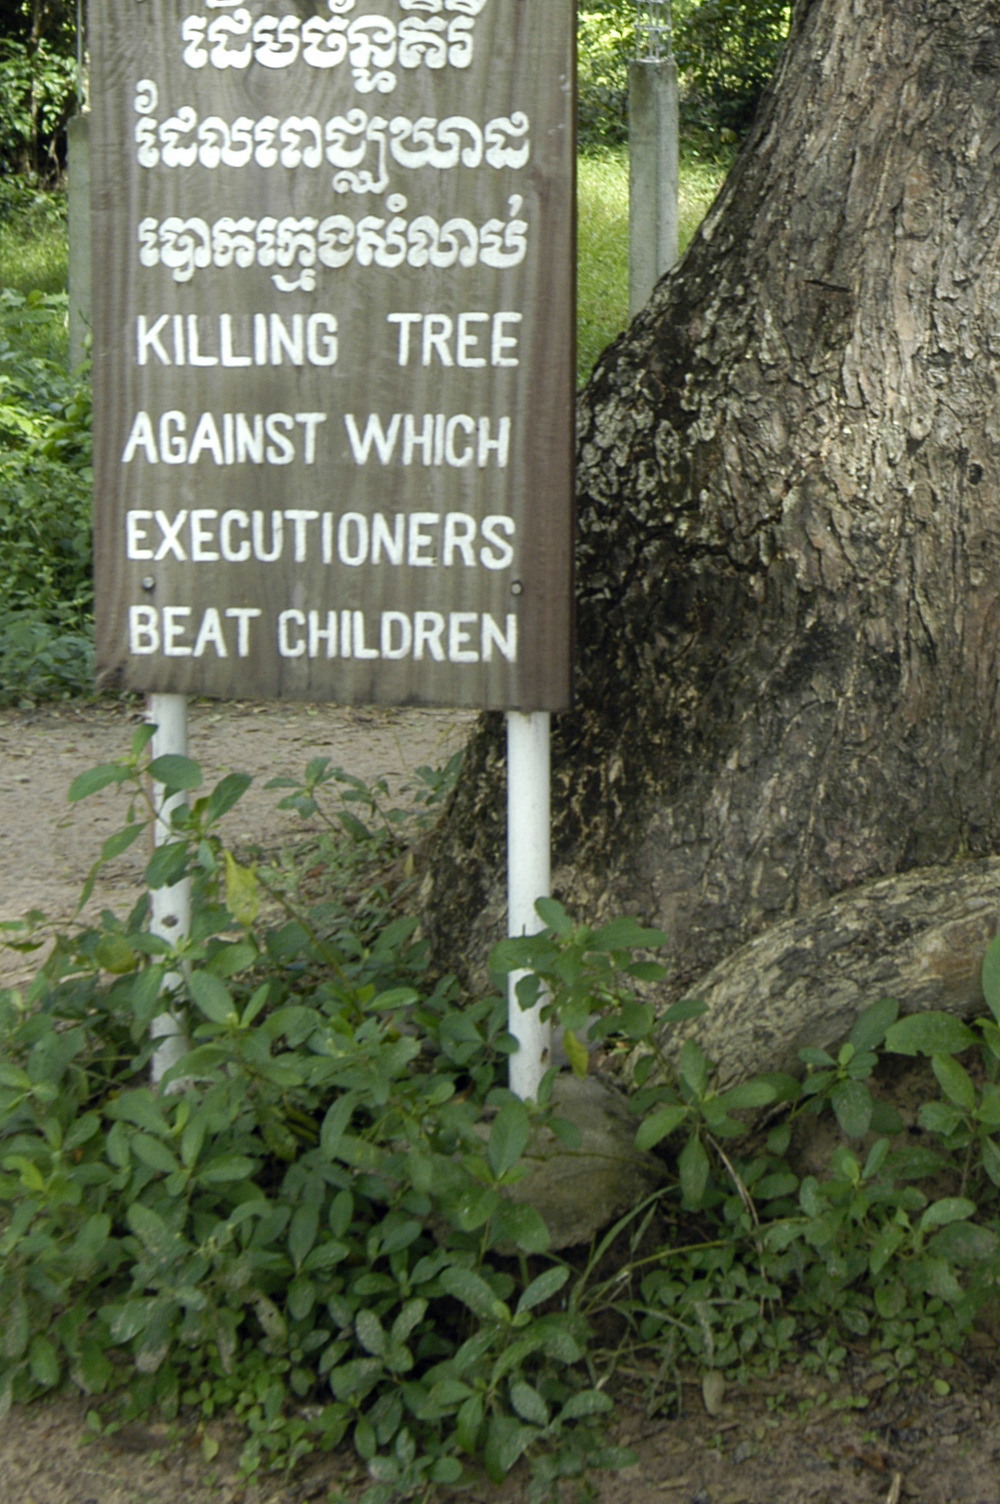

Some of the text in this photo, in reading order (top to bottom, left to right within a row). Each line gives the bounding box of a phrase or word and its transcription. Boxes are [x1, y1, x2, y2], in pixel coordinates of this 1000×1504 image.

[136, 311, 523, 368] KILLING TREE
[121, 410, 511, 469] AGAINST WHICH
[125, 508, 516, 570] EXECUTIONERS
[128, 605, 518, 663] BEAT CHILDREN
